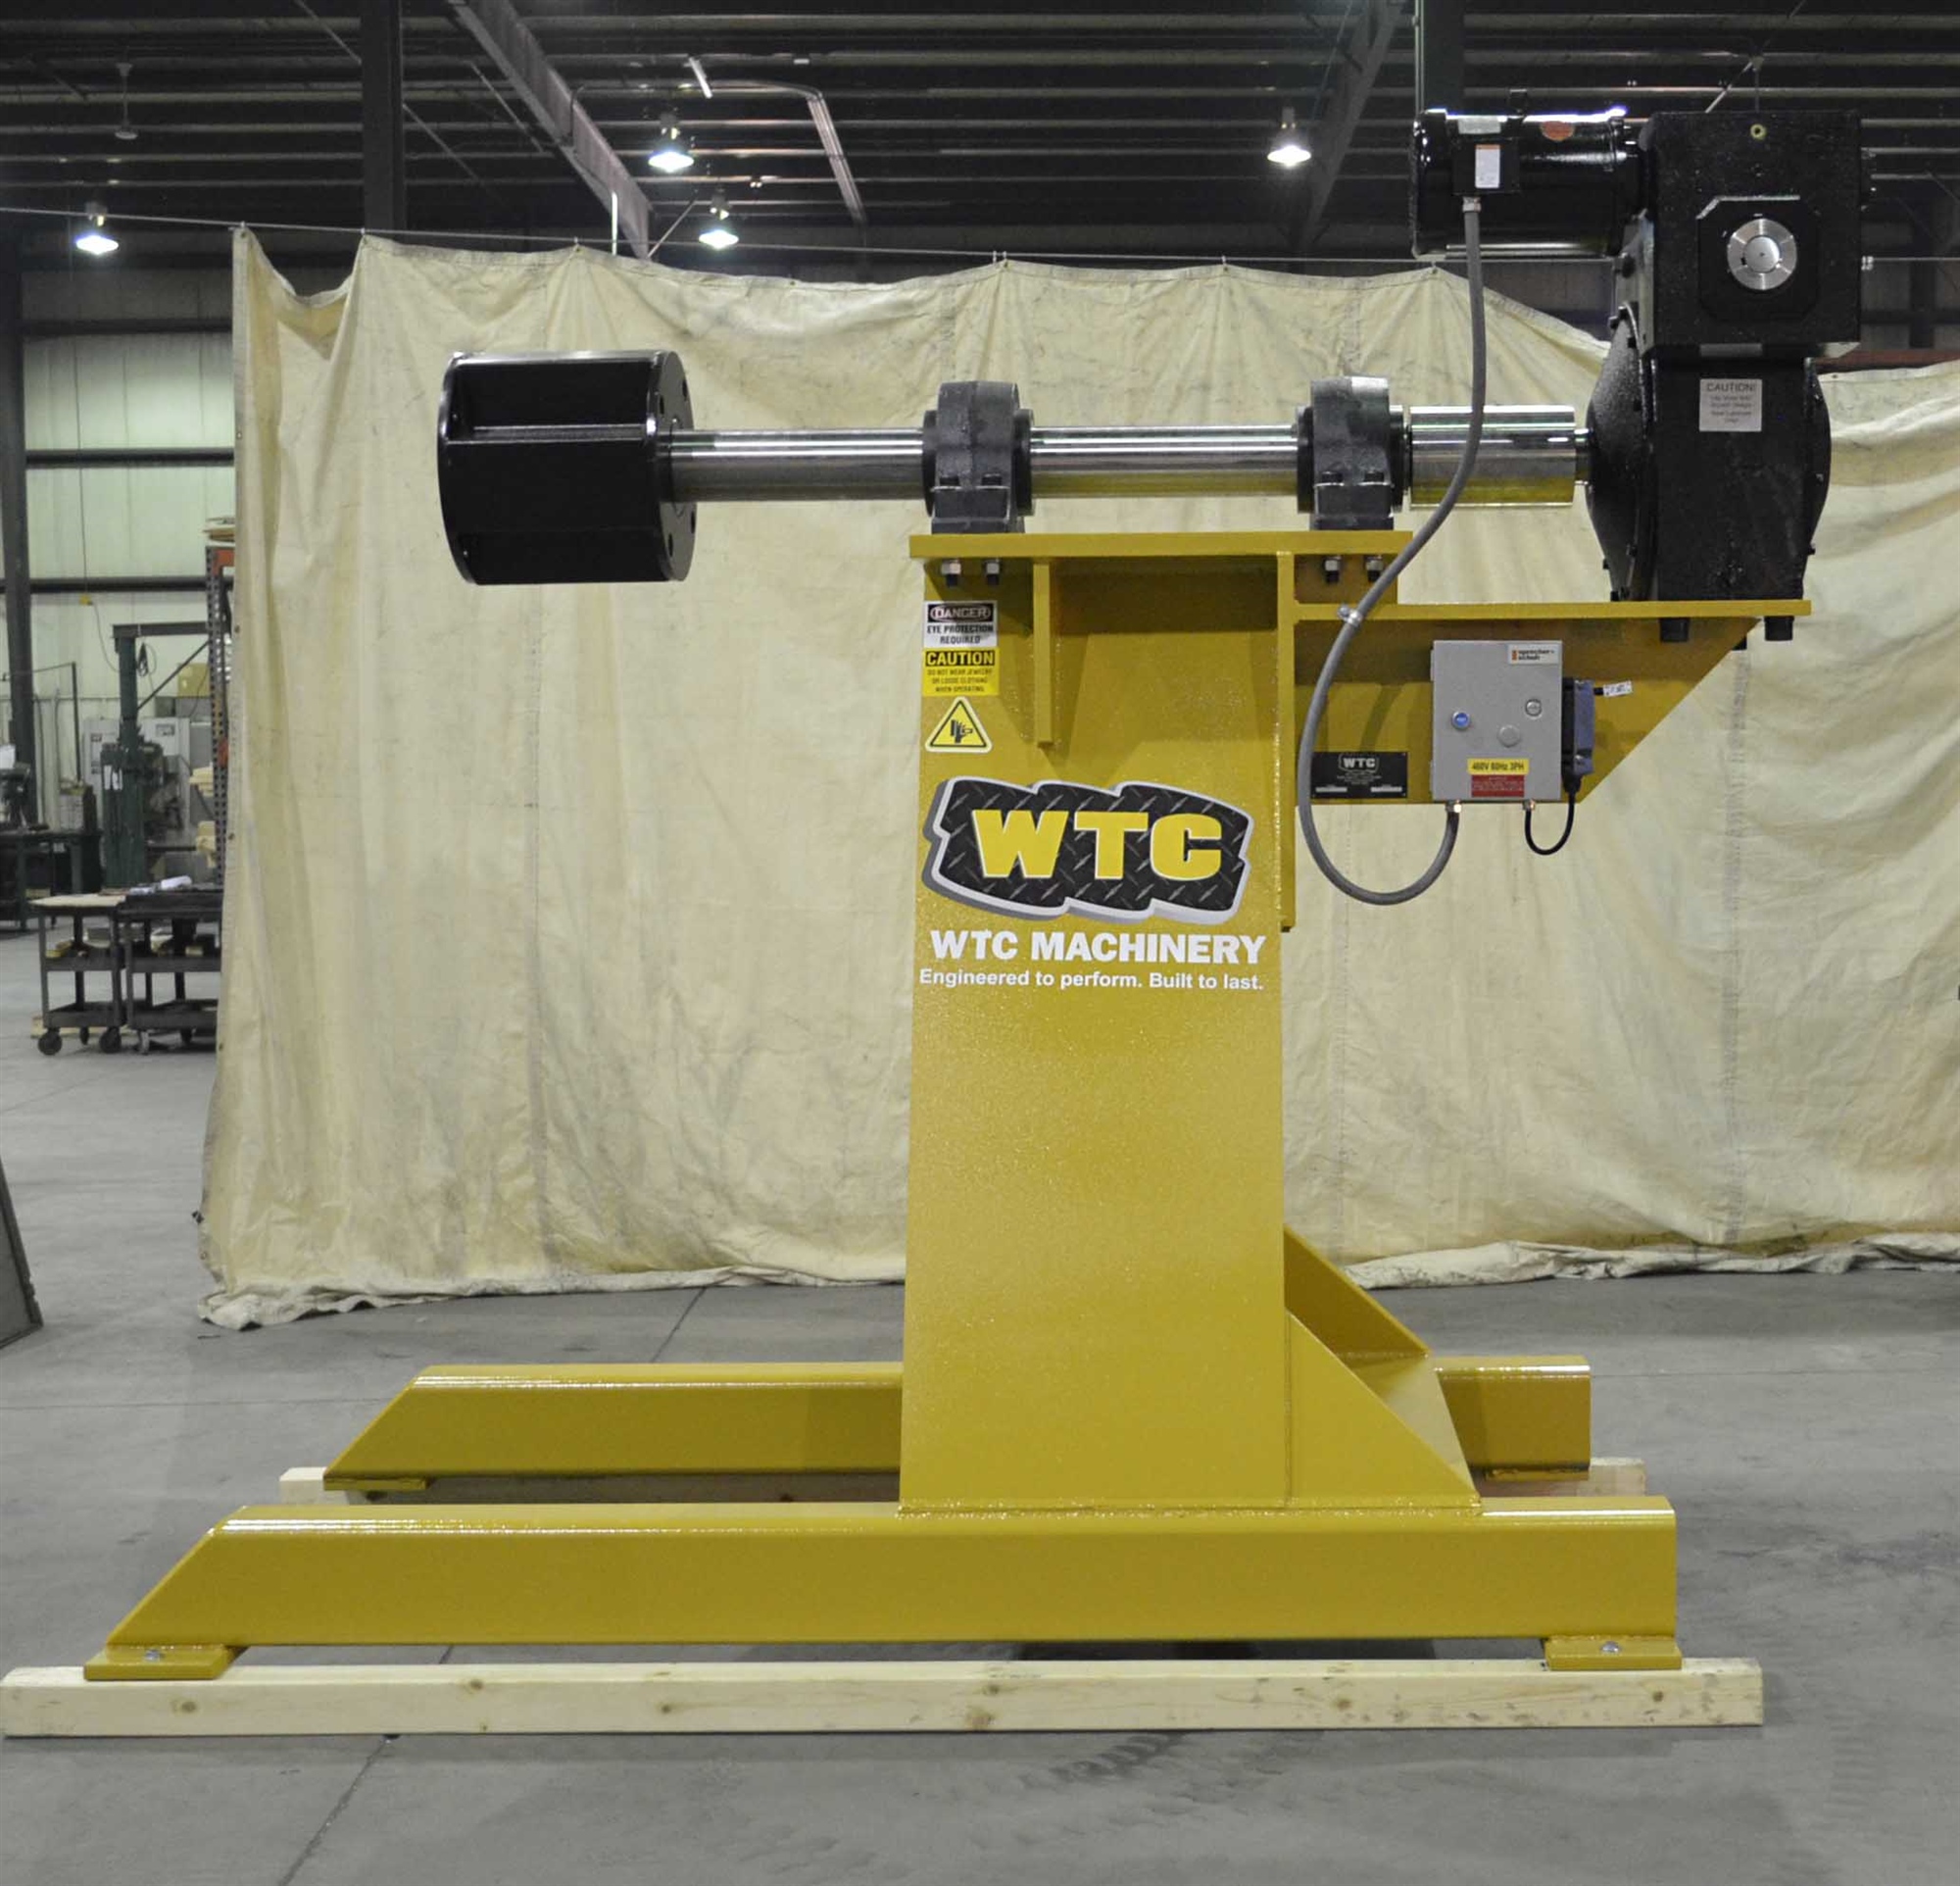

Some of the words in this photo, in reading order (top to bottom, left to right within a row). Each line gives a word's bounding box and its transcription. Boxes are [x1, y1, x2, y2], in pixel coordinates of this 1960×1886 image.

[934, 607, 986, 619] DANGER
[927, 624, 942, 634] EYE
[944, 624, 994, 634] PROTECTION
[940, 635, 981, 645] REQUIRED
[927, 651, 994, 666] CAUTION
[1343, 757, 1376, 769] WTC
[971, 809, 1223, 881] WTC
[930, 929, 1018, 960] WTC
[1031, 931, 1266, 965] MACHINERY
[919, 968, 1030, 988] Engineered
[1035, 970, 1054, 986] to
[1060, 969, 1143, 990] perform.
[1149, 971, 1194, 988] Built
[1199, 973, 1218, 989] to
[1223, 973, 1264, 990] last.
